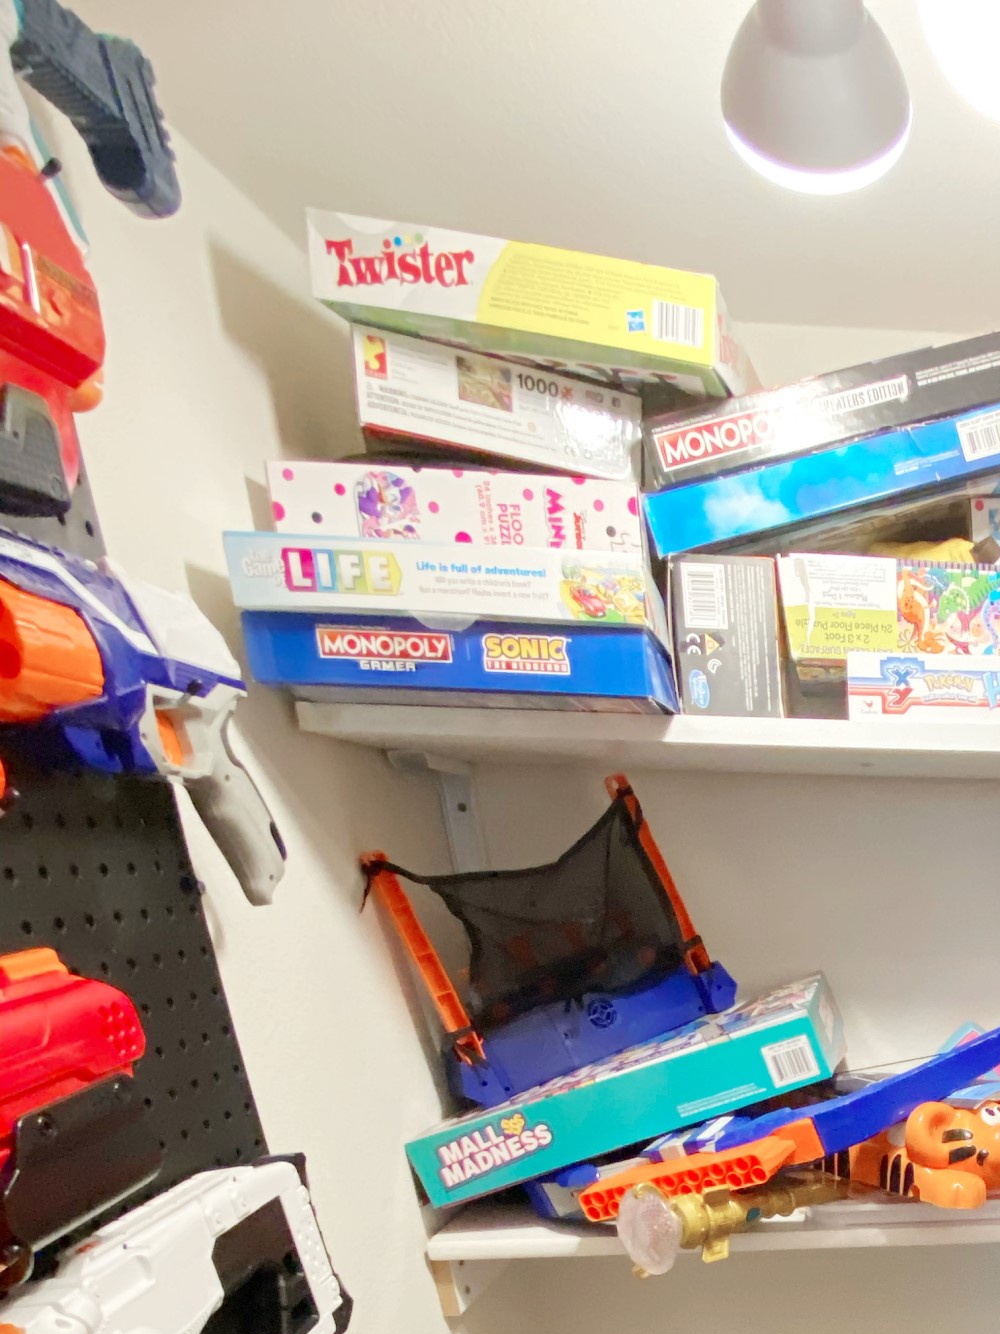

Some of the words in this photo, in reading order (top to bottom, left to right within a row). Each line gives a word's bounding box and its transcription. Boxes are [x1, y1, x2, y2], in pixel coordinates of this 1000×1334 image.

[325, 238, 475, 288] Twister
[516, 372, 559, 398] 1000
[866, 381, 905, 404] EDITION
[662, 413, 774, 464] MONOPO
[498, 503, 512, 546] PUZZL
[508, 503, 524, 546] FLOO
[286, 550, 394, 592] LIFE
[416, 561, 436, 571] Life
[439, 562, 448, 572] is
[450, 563, 468, 573] full
[470, 565, 482, 574] of
[485, 565, 546, 577] adventures!
[825, 632, 845, 643] Foot
[830, 621, 853, 632] Floor
[847, 634, 854, 643] 3
[854, 622, 879, 633] Piece
[863, 634, 870, 644] 2
[881, 623, 893, 633] 24
[322, 633, 446, 659] MONOPOLY
[484, 634, 566, 661] SONIC
[359, 659, 417, 672] GAMER
[438, 1125, 505, 1165] MALL
[441, 1124, 553, 1188] MADNESS
